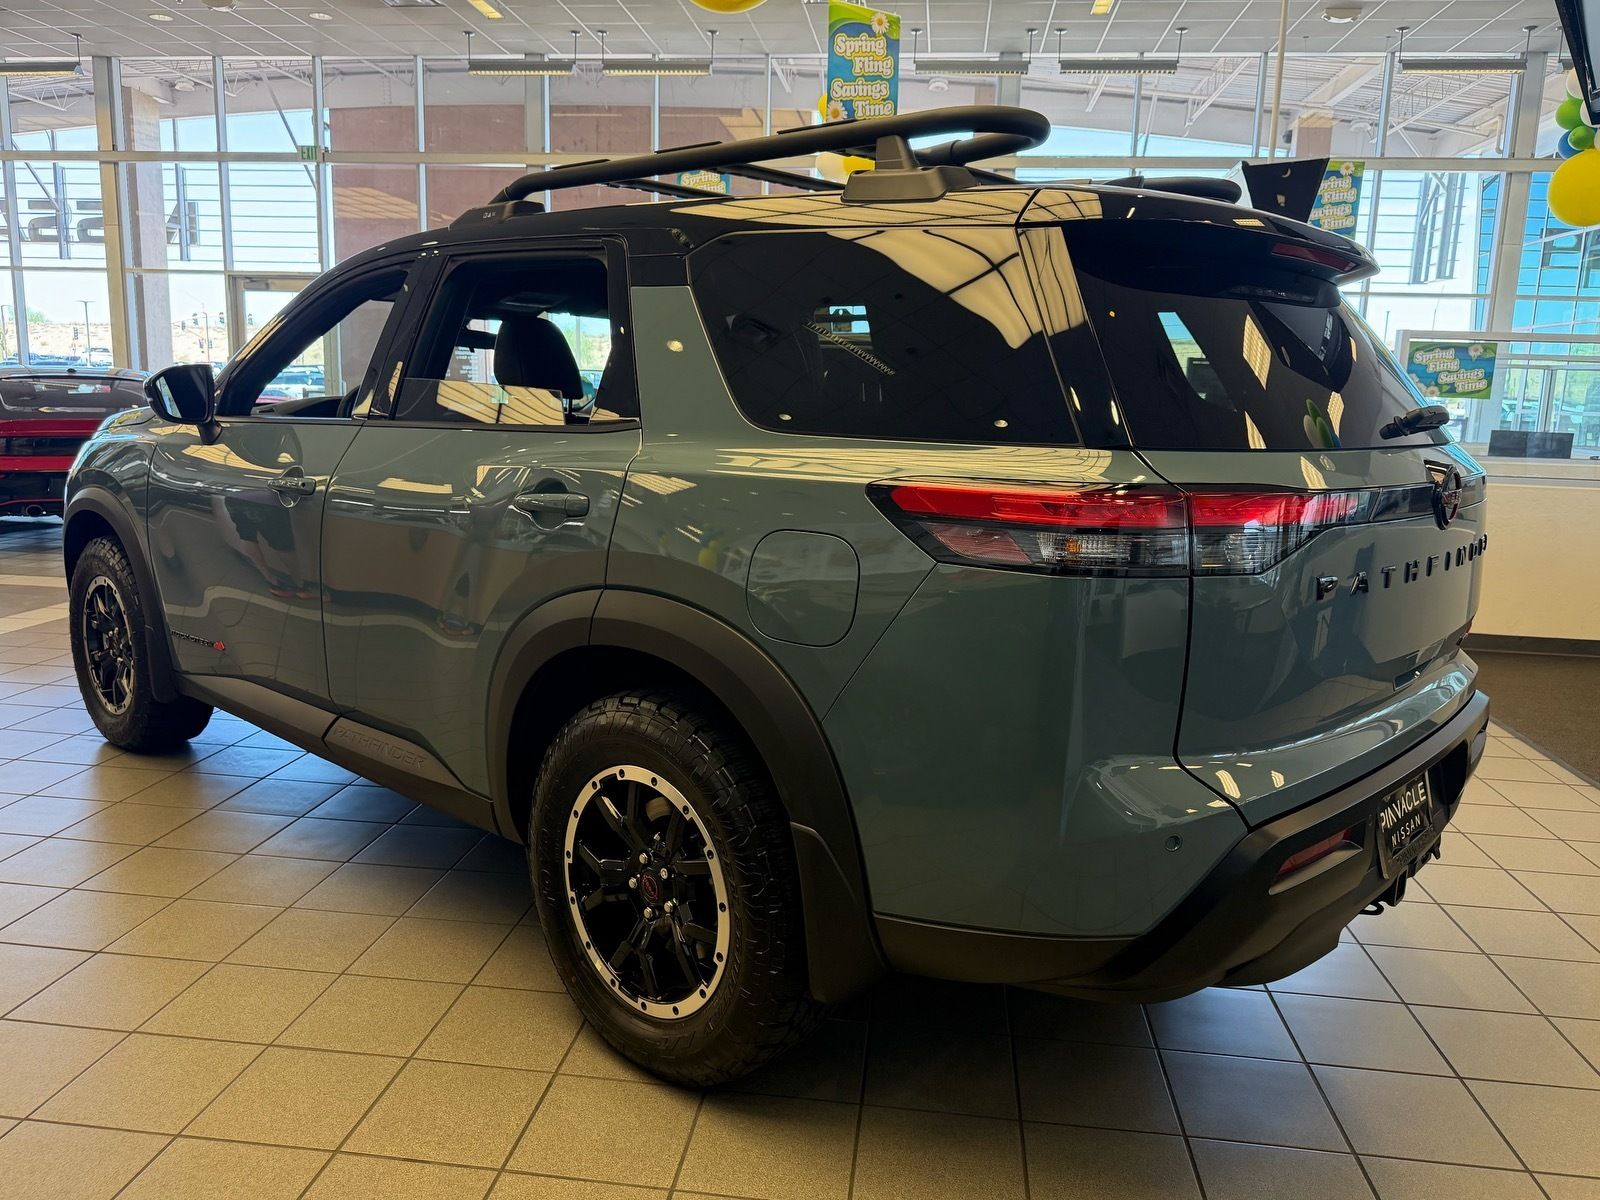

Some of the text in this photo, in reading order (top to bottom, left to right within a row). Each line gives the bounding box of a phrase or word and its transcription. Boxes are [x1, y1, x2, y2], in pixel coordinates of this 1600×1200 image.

[835, 35, 885, 57] Spring
[853, 56, 893, 77] Fling
[831, 79, 888, 99] Savings
[854, 100, 893, 117] Time
[301, 146, 318, 160] EXIT
[1311, 205, 1351, 218] avings
[1414, 348, 1455, 364] Spring
[1427, 359, 1459, 373] Fling
[1439, 369, 1484, 384] Savings
[1456, 380, 1487, 392] Time
[333, 726, 427, 769] PATHFINDER
[1391, 814, 1421, 847] NISSAN
